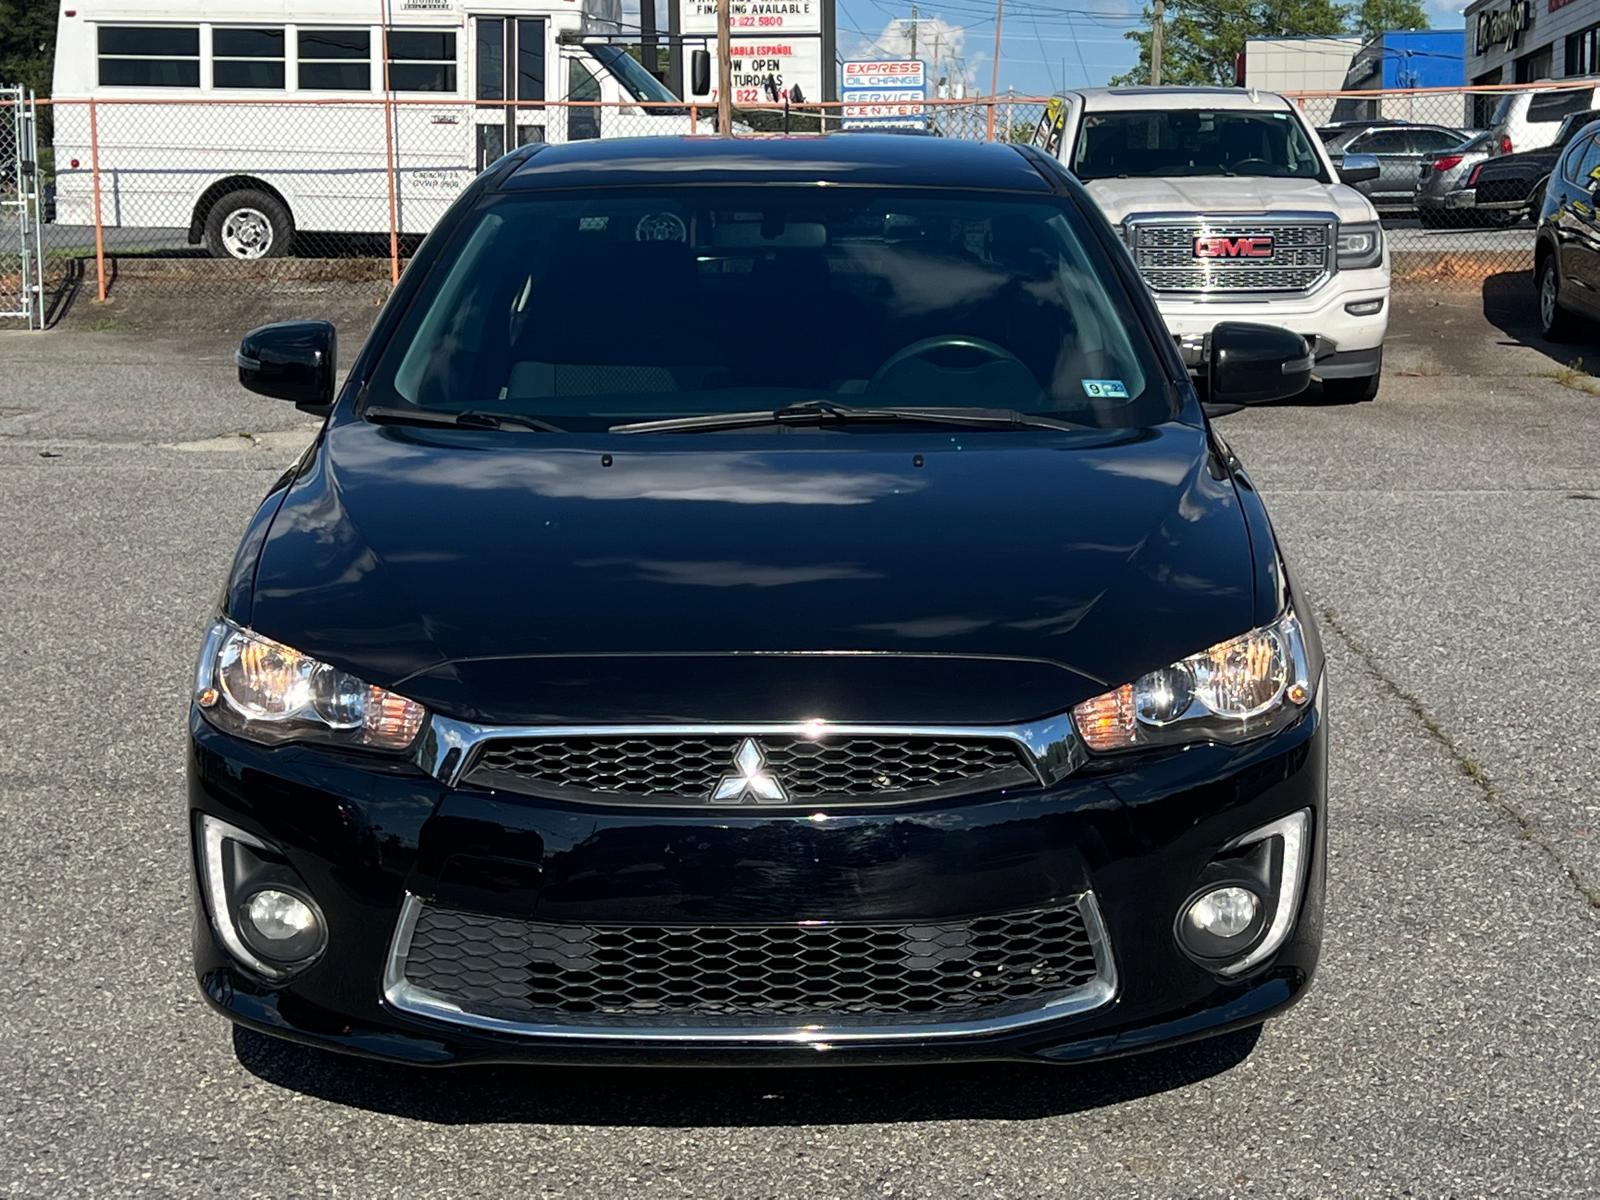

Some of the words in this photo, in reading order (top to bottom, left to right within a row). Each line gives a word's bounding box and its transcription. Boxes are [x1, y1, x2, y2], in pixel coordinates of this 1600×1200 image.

[697, 5, 747, 14] FINAING
[752, 4, 810, 14] AVAILABLE
[757, 44, 792, 55] ESPAÑOL
[752, 59, 780, 71] OPEN
[846, 63, 921, 73] EXPRESS
[729, 75, 783, 87] TURDAS
[846, 77, 866, 85] OIL
[869, 76, 921, 85] CHANGE
[847, 93, 921, 103] SERVICE
[846, 105, 921, 116] CENTER
[1196, 238, 1272, 257] GMC
[1090, 384, 1100, 394] 9
